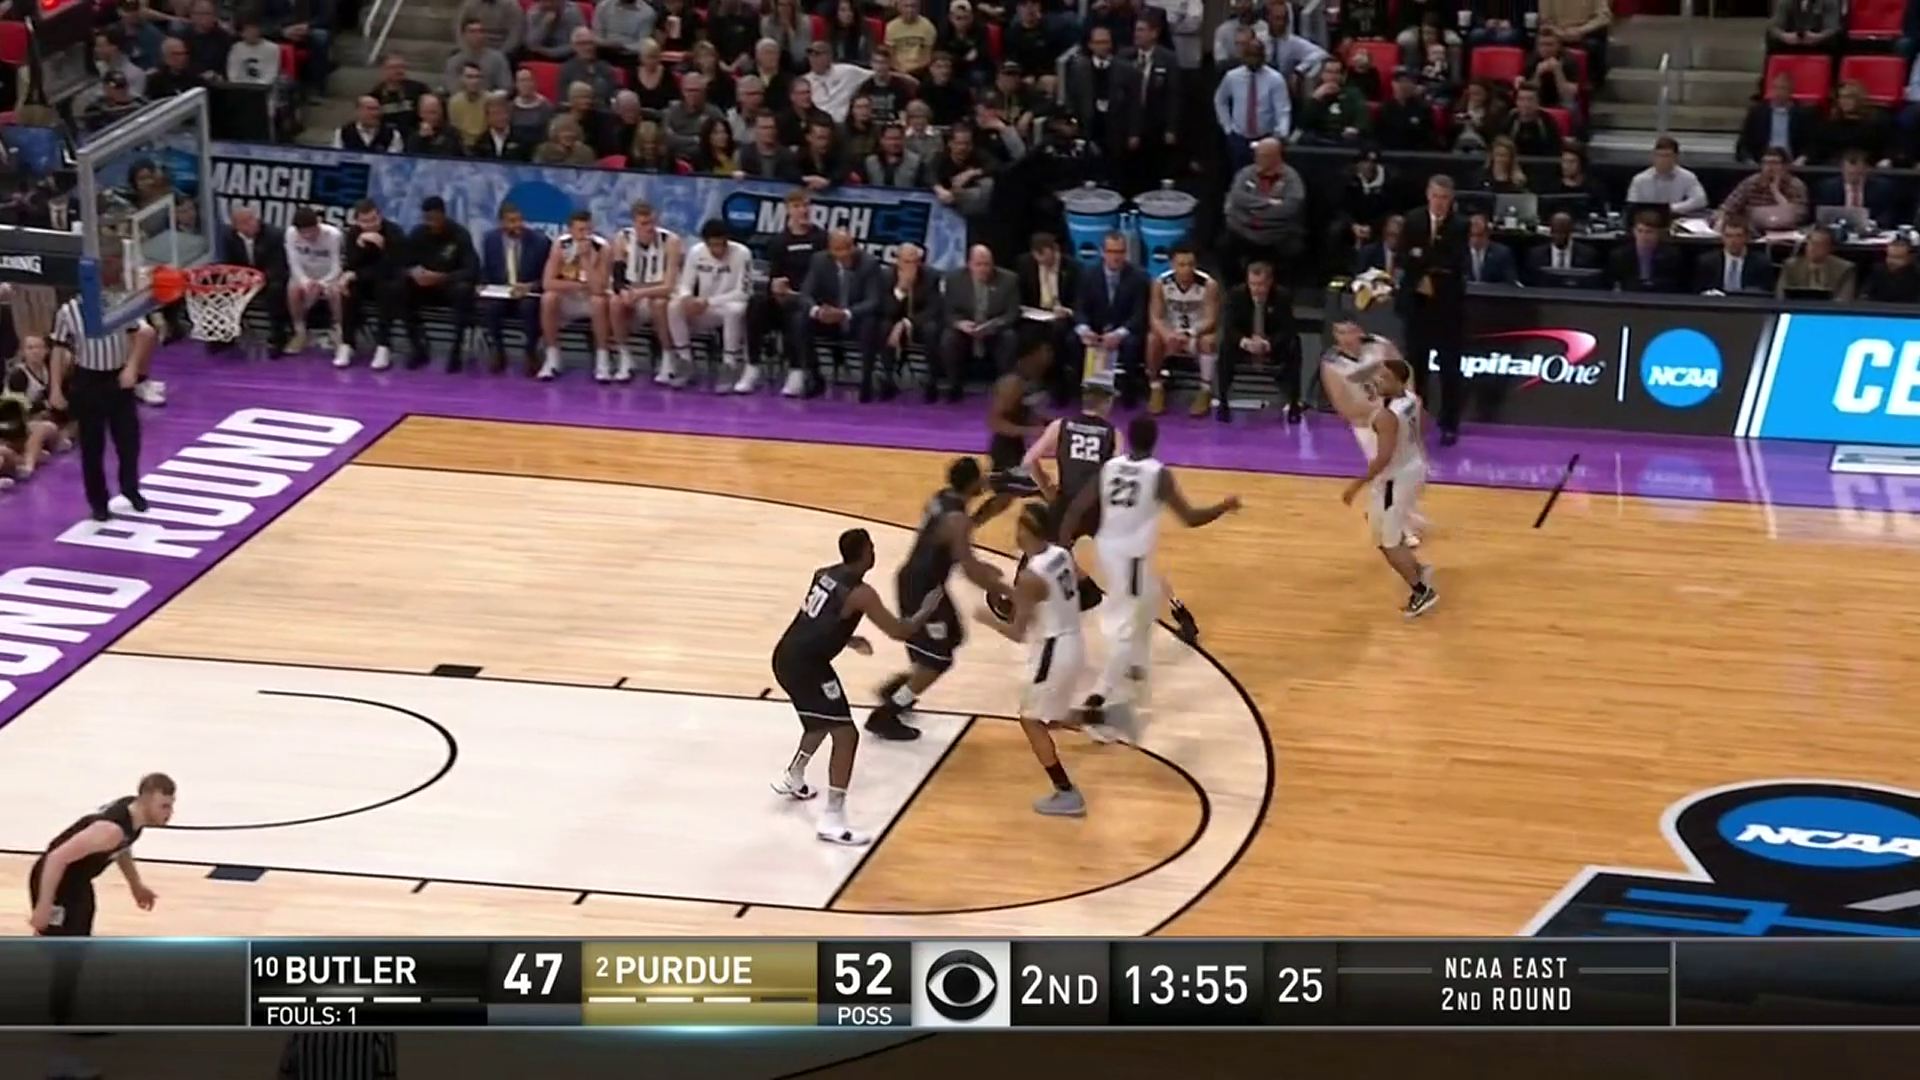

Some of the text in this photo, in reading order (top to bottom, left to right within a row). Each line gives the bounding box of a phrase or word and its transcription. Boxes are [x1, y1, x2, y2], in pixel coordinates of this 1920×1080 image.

[211, 161, 312, 200] MARCH
[756, 200, 872, 240] MRCH
[1648, 366, 1718, 388] NCAA
[1070, 434, 1101, 462] 22
[55, 408, 364, 558] ROUND
[1736, 824, 1920, 857] NCAA
